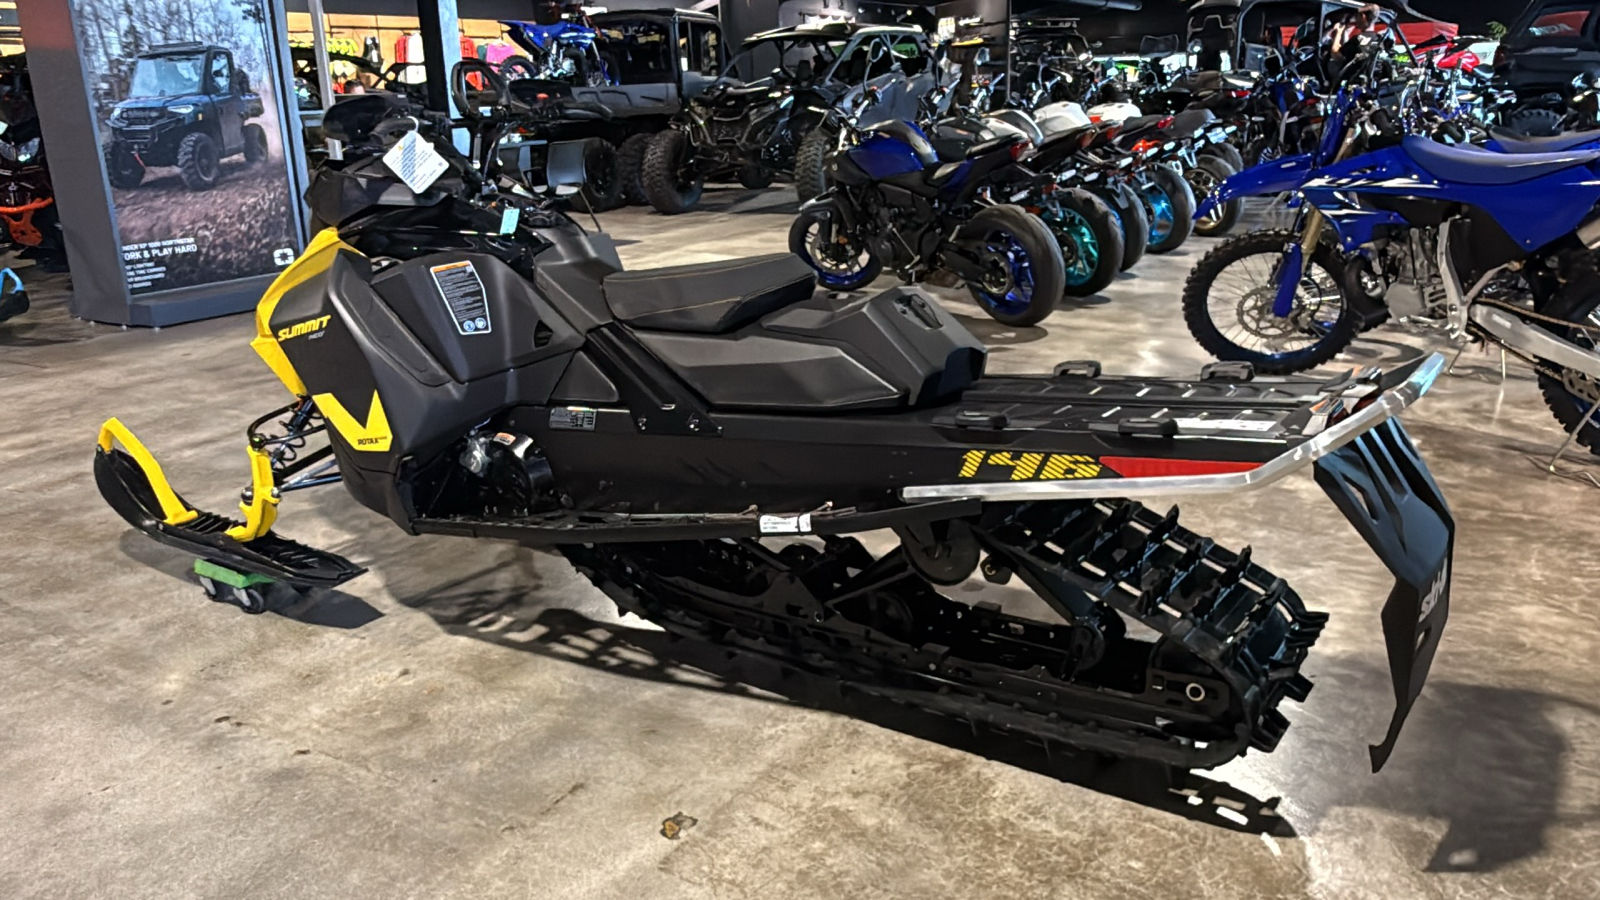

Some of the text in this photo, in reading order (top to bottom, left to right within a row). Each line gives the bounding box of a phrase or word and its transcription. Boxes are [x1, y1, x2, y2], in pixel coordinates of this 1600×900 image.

[123, 244, 198, 260] ORK & PLAY HARD
[278, 314, 331, 342] SUMMIT
[357, 437, 379, 446] ROTAX
[958, 450, 1102, 480] 146
